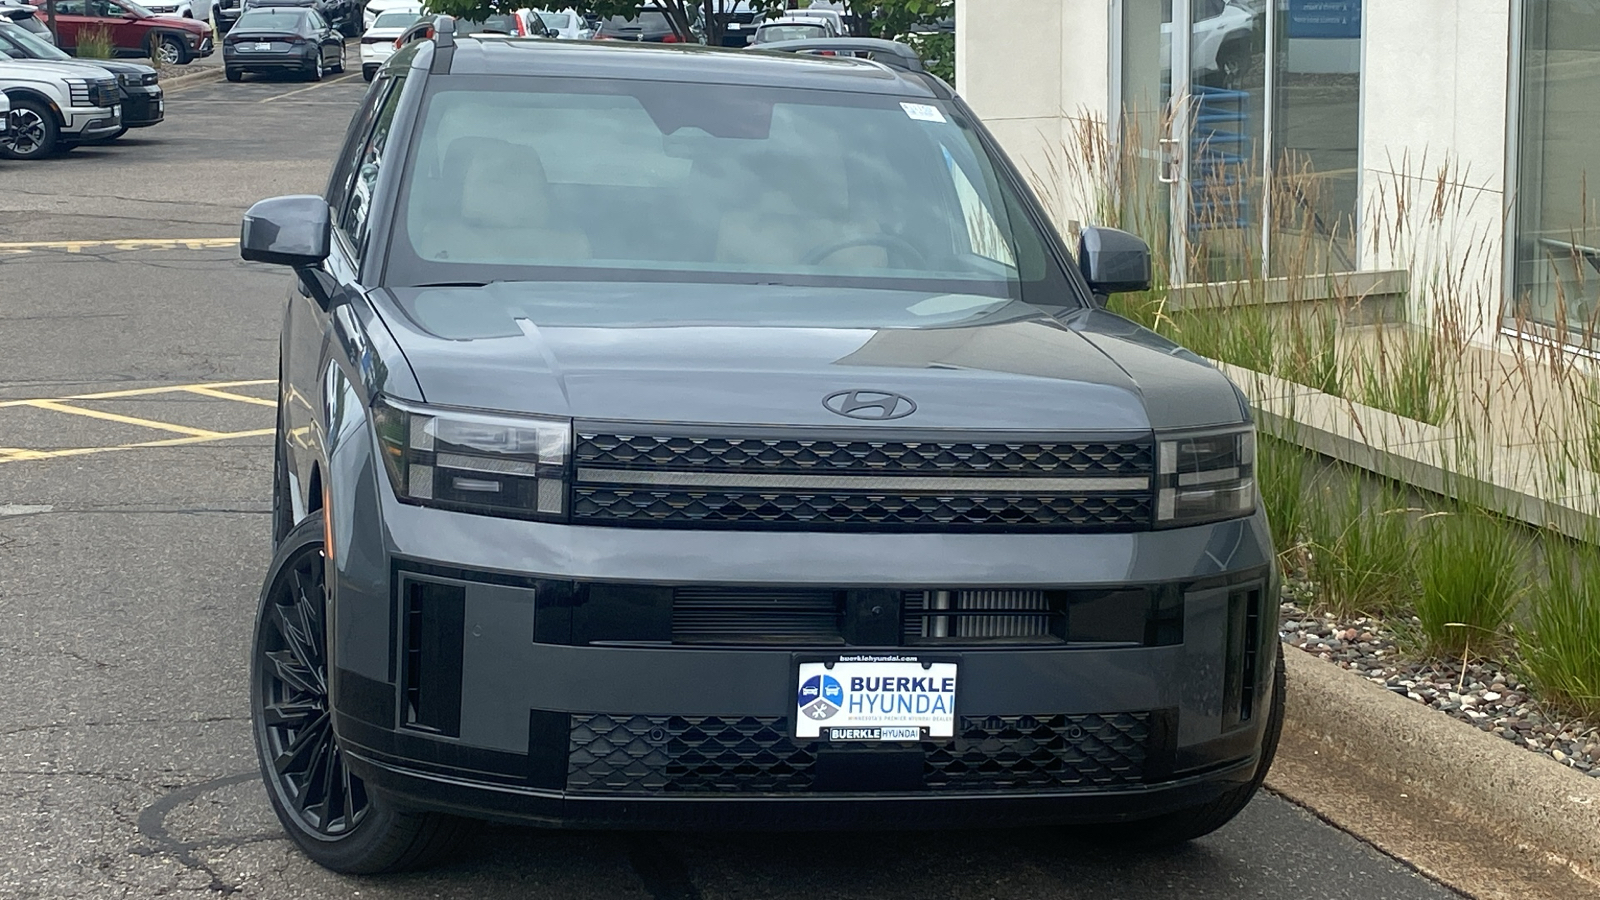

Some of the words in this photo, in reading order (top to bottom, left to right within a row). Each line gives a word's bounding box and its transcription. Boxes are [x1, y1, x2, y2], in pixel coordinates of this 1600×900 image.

[850, 677, 954, 692] BUERKLE
[849, 694, 954, 714] HYUNDAI
[832, 729, 880, 739] BUERKLE
[882, 729, 918, 738] HYUNDAI
